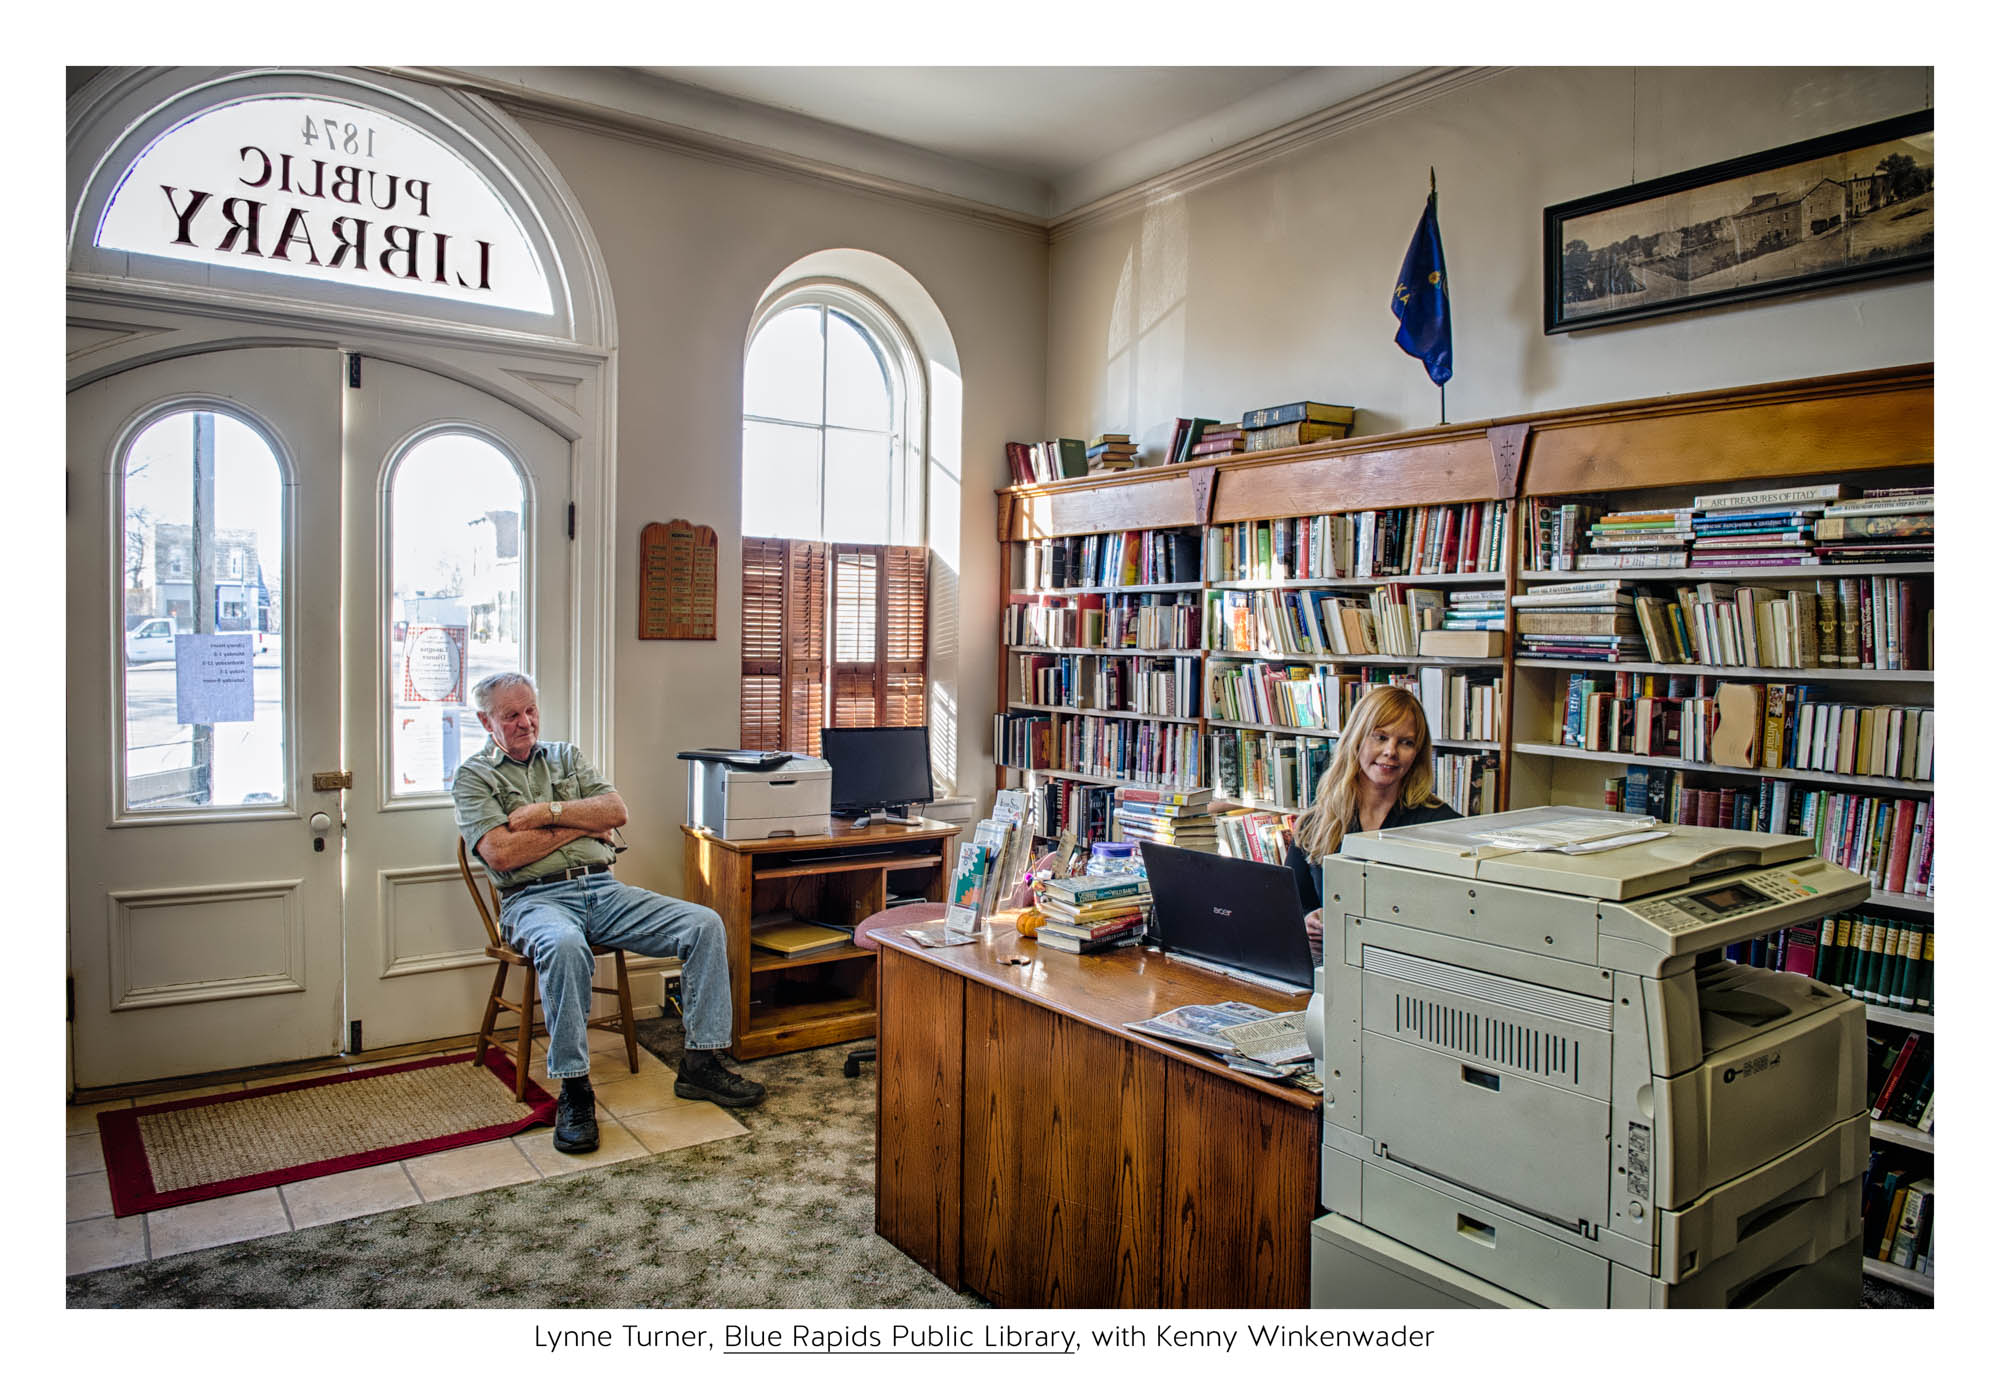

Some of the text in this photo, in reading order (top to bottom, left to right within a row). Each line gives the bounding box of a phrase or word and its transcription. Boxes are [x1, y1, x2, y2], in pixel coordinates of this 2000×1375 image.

[1710, 490, 1817, 507] ART TREASURES OF ITALY
[1213, 906, 1232, 916] acer
